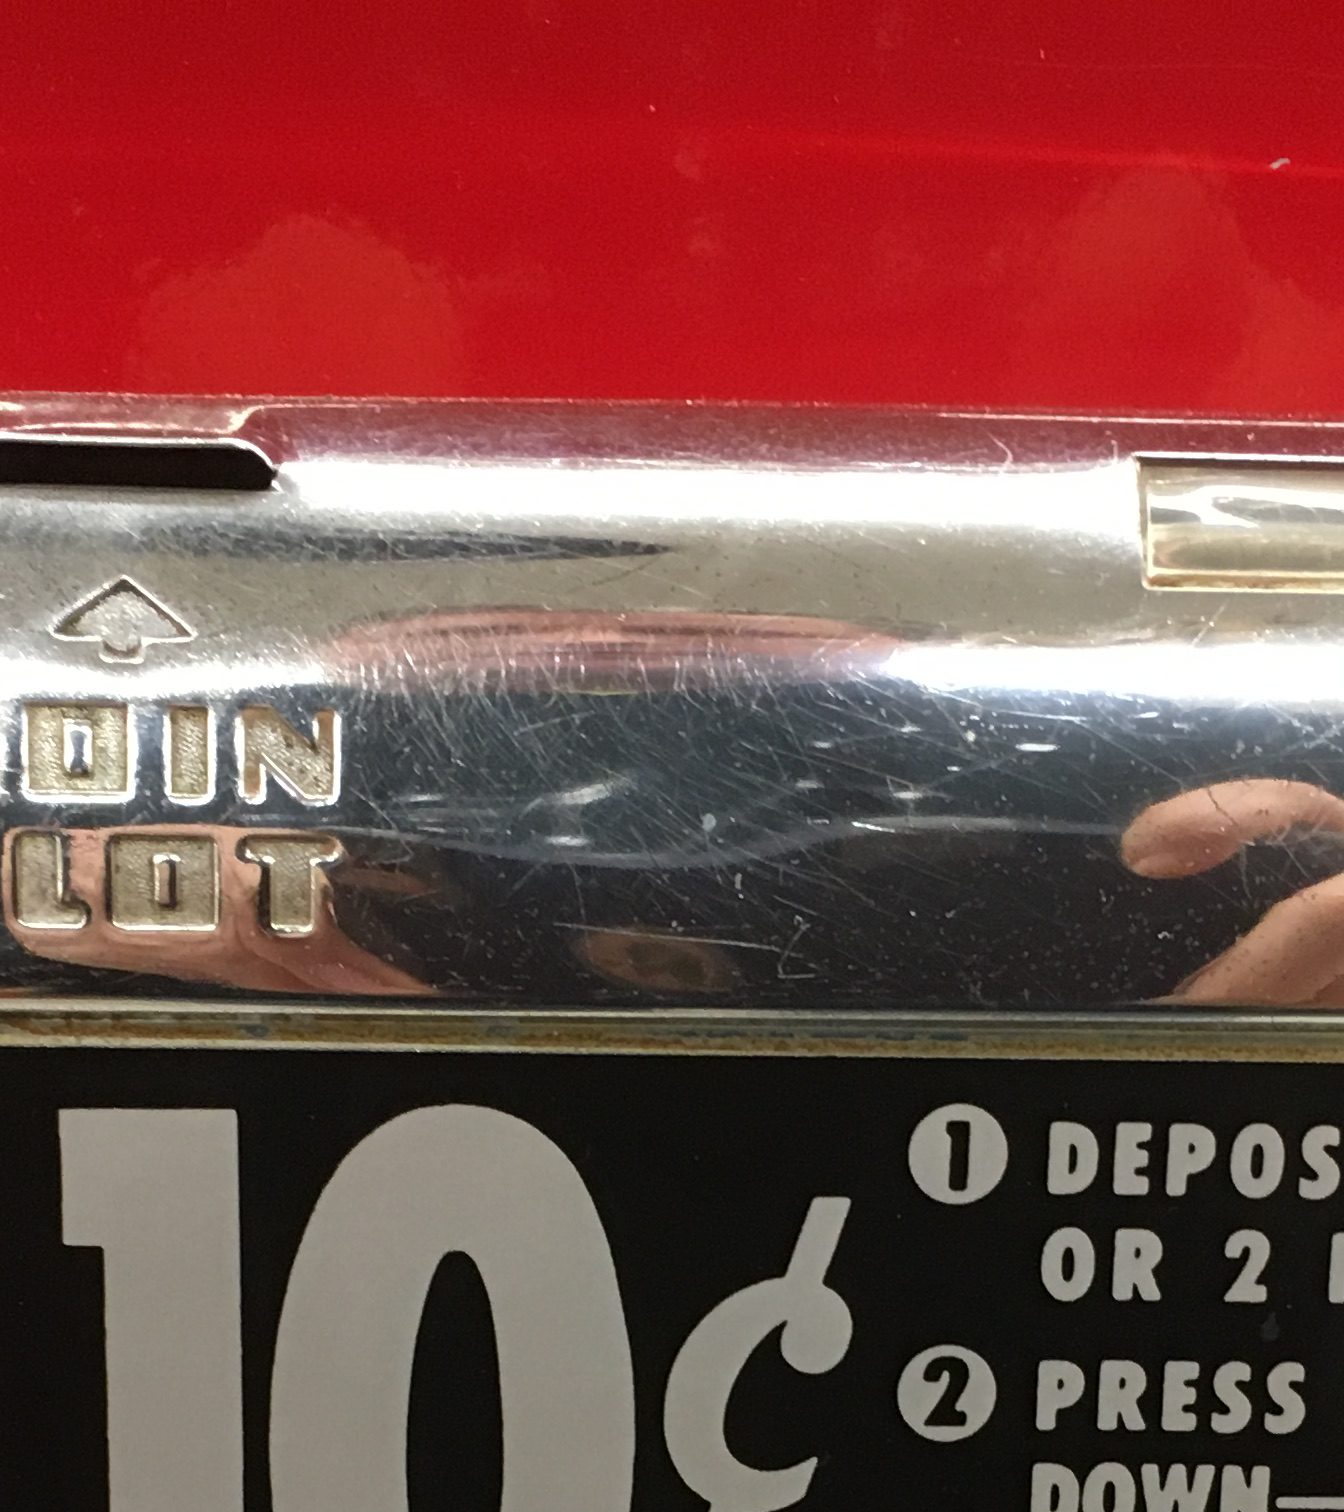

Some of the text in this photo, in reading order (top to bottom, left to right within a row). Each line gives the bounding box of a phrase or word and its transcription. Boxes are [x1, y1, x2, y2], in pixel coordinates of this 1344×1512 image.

[1042, 1228, 1162, 1301] OR
[1225, 1230, 1270, 1302] 2
[1037, 1361, 1305, 1434] PRESS
